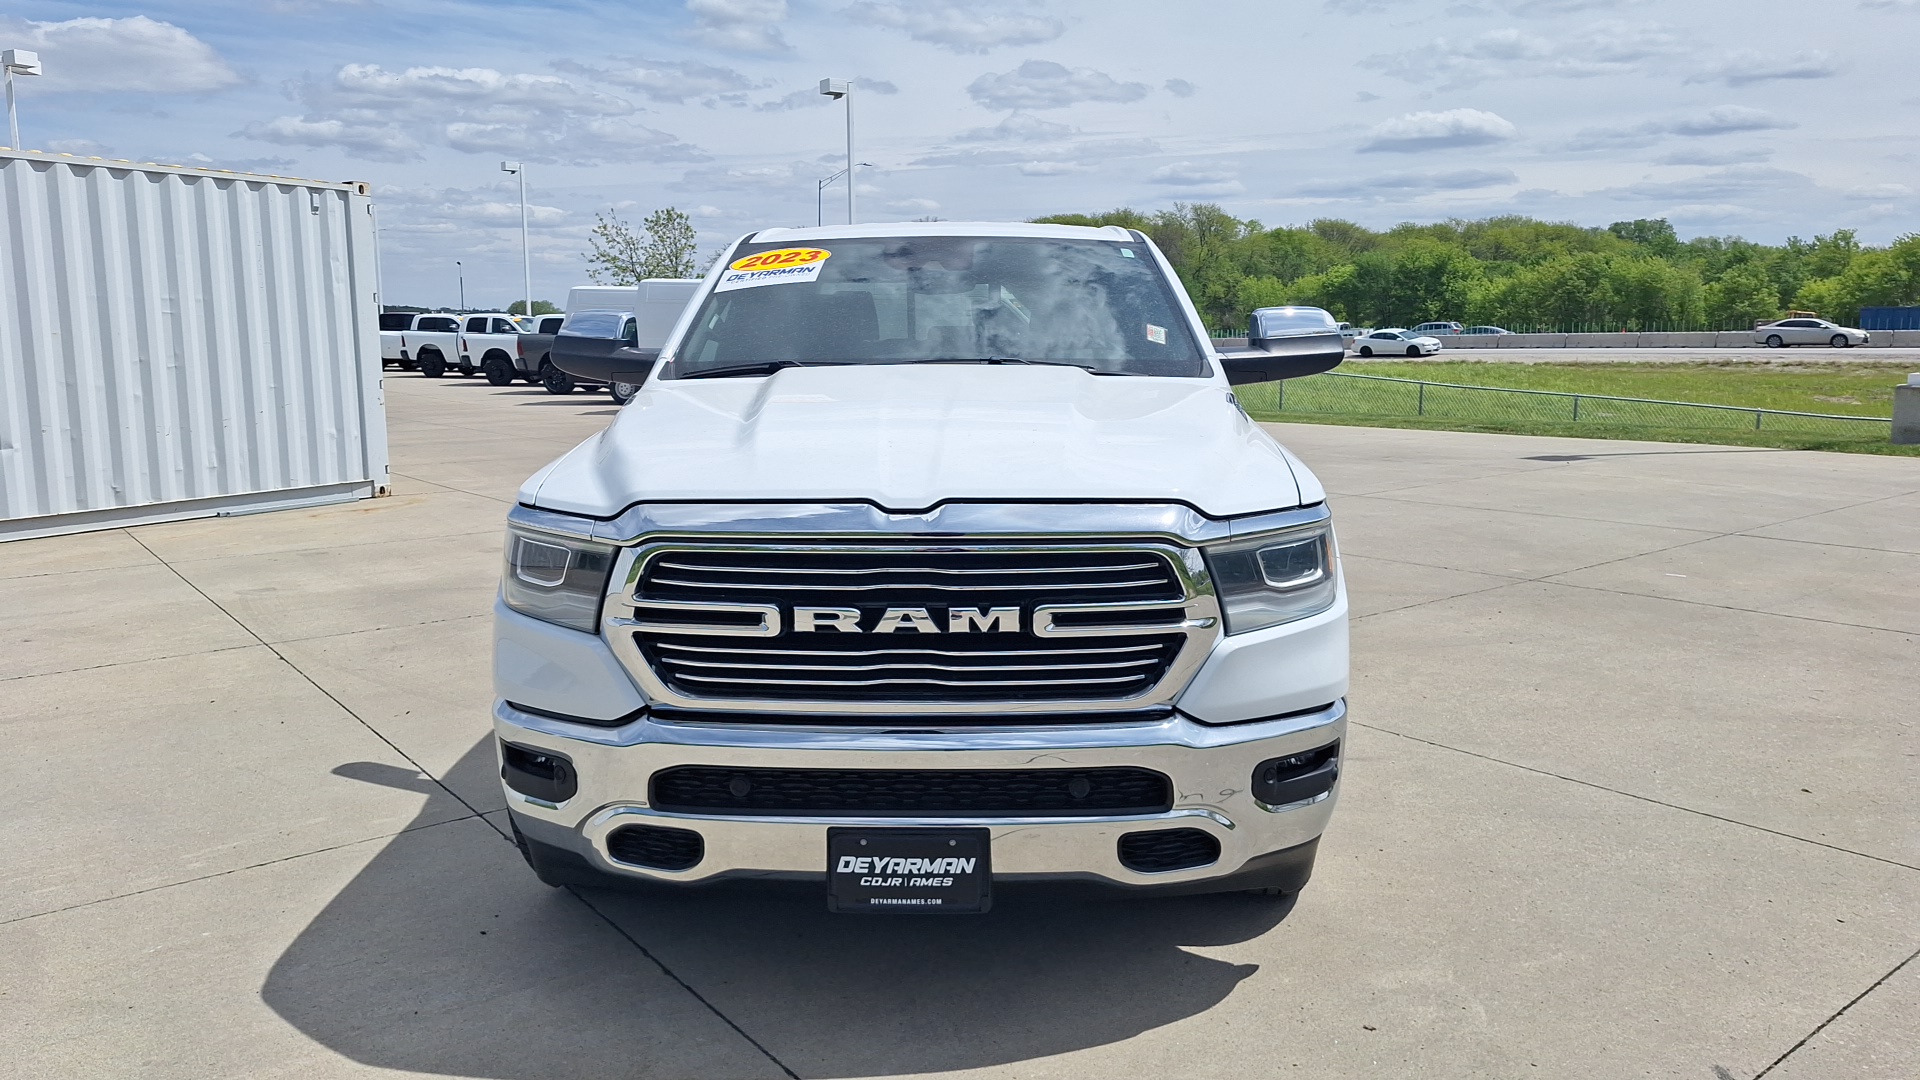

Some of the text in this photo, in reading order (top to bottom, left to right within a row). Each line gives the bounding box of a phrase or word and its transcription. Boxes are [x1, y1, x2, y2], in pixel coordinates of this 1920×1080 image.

[739, 250, 822, 269] 2023
[726, 266, 816, 283] DEYARMAN
[793, 606, 1021, 633] RAM
[836, 855, 977, 875] DEYARMAN
[860, 877, 954, 887] CDJR AMES
[870, 897, 943, 905] DEYARMANAMES.COM
